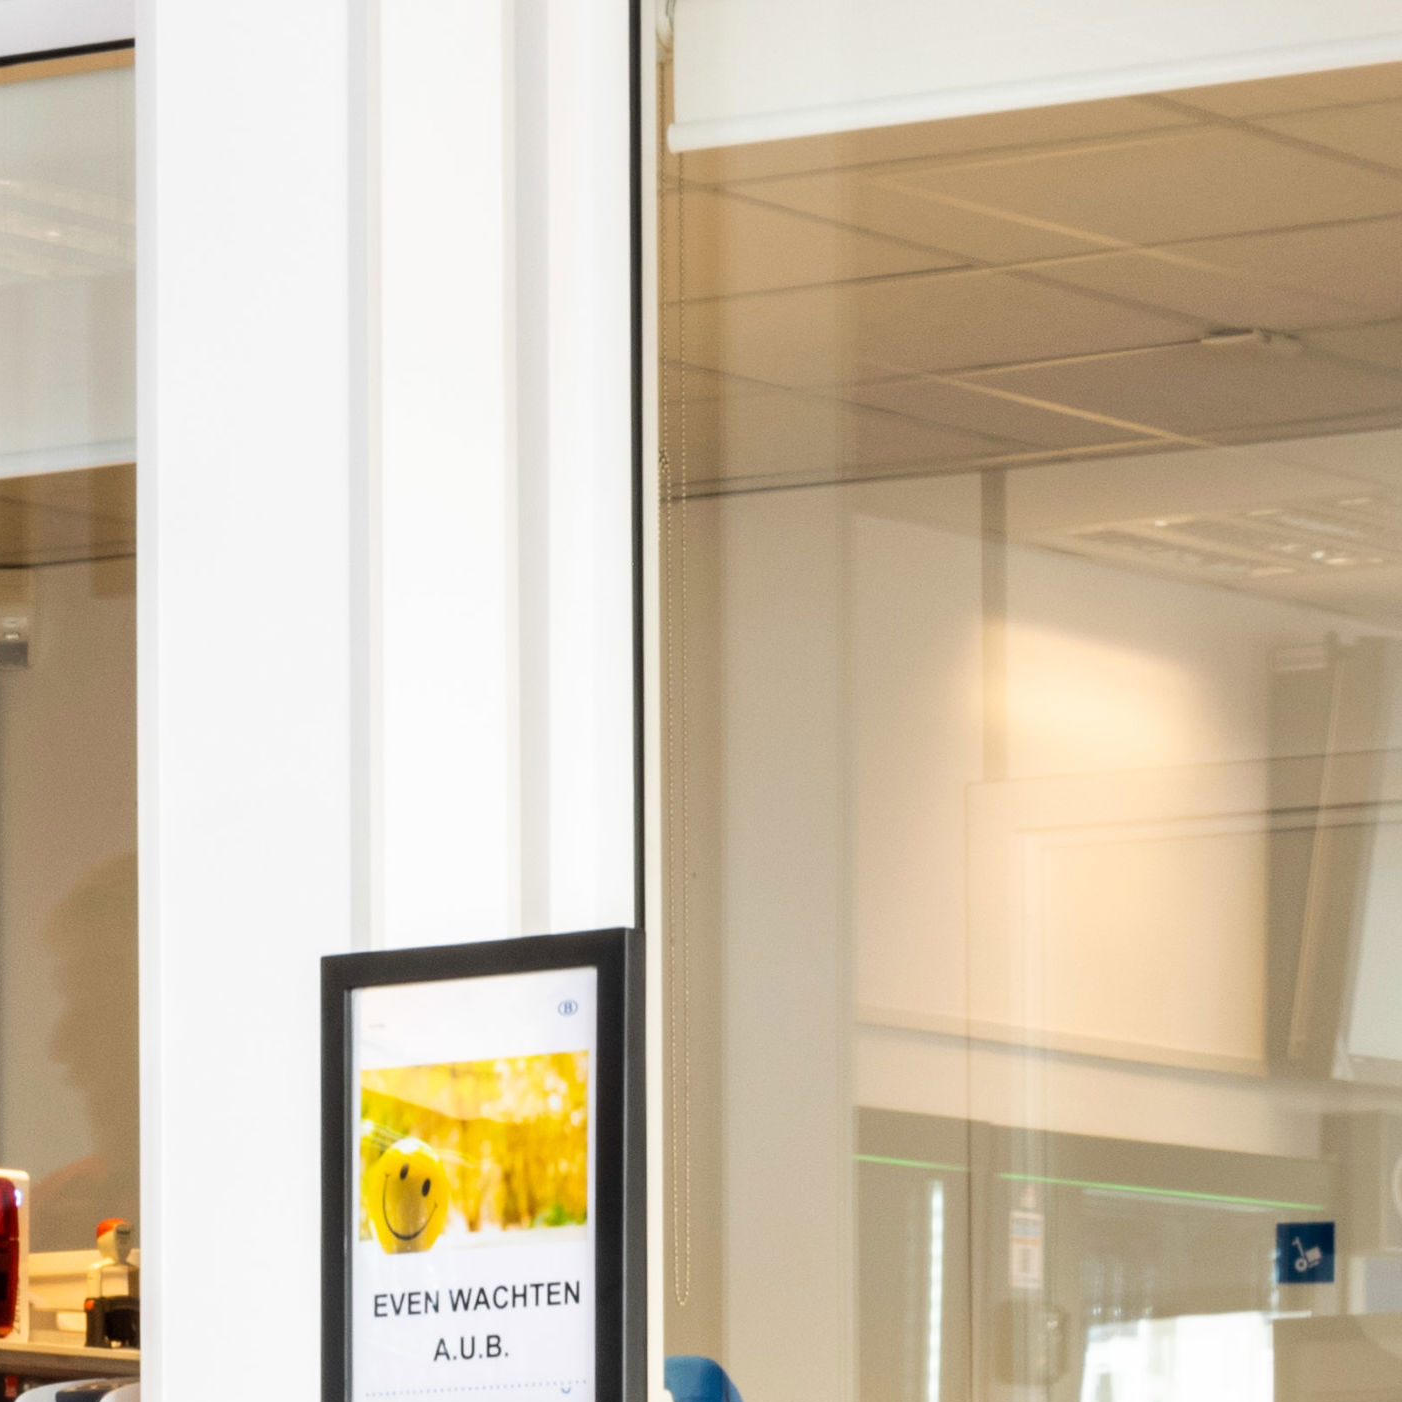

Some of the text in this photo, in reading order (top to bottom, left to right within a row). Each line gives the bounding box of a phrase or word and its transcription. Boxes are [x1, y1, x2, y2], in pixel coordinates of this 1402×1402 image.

[374, 1281, 580, 1318] EVEN WACHTEN
[433, 1334, 509, 1361] A.U.B.
